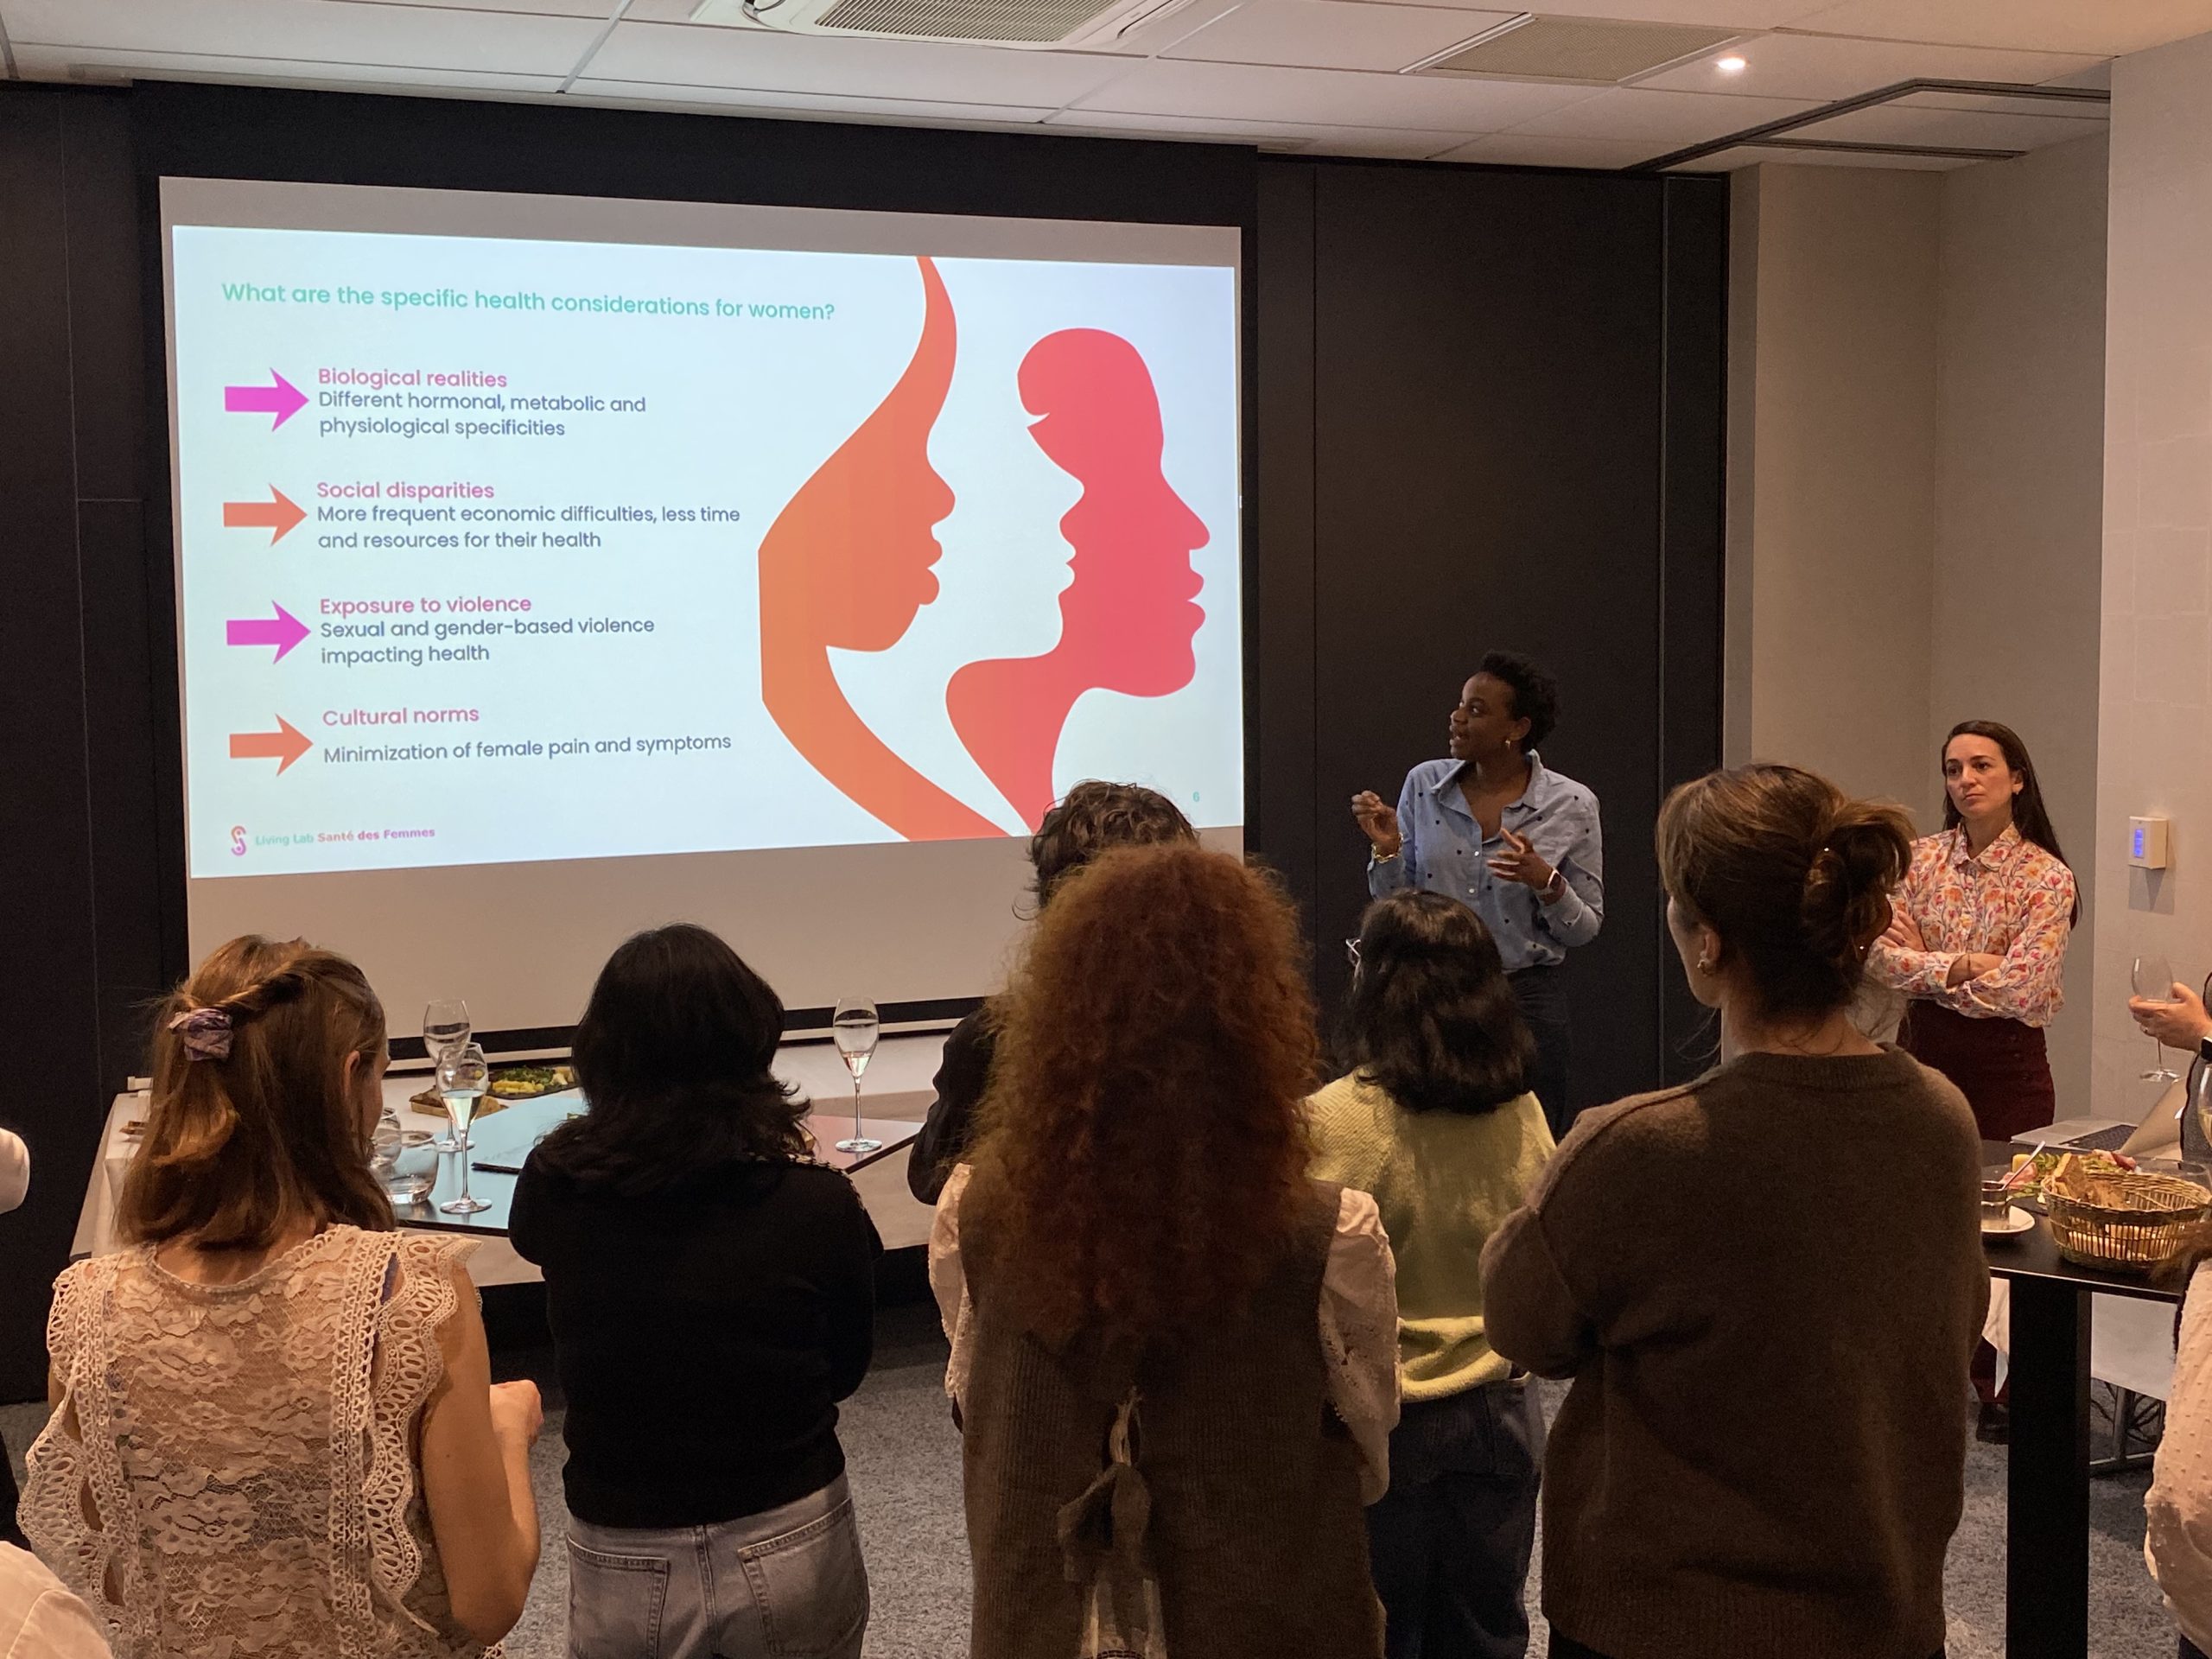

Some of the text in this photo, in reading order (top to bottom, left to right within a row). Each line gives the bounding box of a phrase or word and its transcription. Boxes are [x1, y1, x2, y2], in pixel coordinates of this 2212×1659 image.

[221, 283, 835, 320] What are the specific health considerations for women?
[319, 367, 507, 389] Biological realities
[320, 391, 645, 412] Different hormonal, metabolic and
[321, 416, 564, 439] physiological specificities
[317, 481, 494, 503] Social disparities
[318, 505, 740, 526] More frequent economic difficulties, less time
[319, 531, 601, 548] and resources for their health
[321, 596, 531, 619] Exposure to violence
[321, 618, 654, 640] Sexual and gender-based violence
[321, 645, 489, 668] impacting health
[323, 708, 479, 726] Cultural norms
[325, 736, 731, 763] Minimization of female pain and symptoms
[1192, 791, 1200, 803] 6
[256, 829, 435, 846] Living Lab Santé des Femmes
